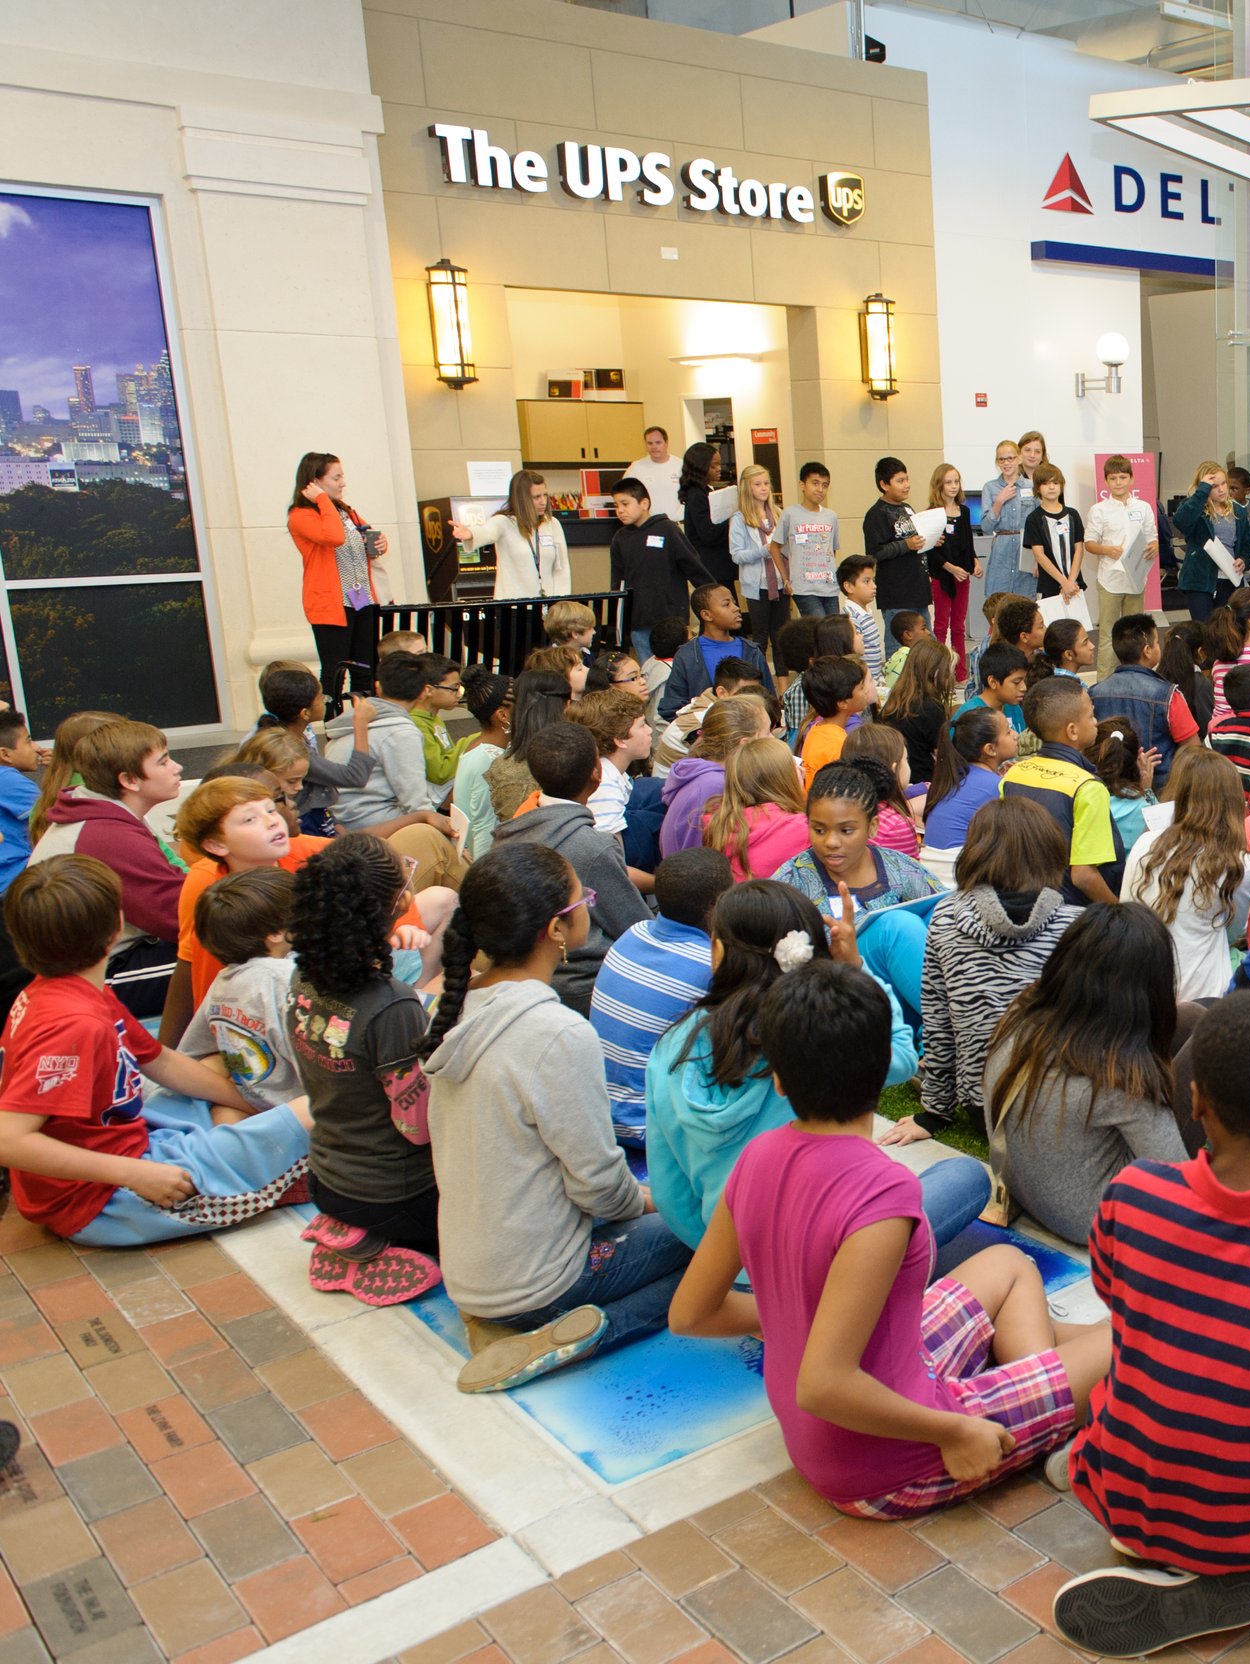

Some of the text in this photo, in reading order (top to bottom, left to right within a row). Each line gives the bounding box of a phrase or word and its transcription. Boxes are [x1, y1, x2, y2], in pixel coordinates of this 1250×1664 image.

[431, 123, 814, 223] The UPS Store
[829, 185, 864, 217] ups
[427, 520, 441, 546] ups
[398, 1080, 428, 1112] CUTE
